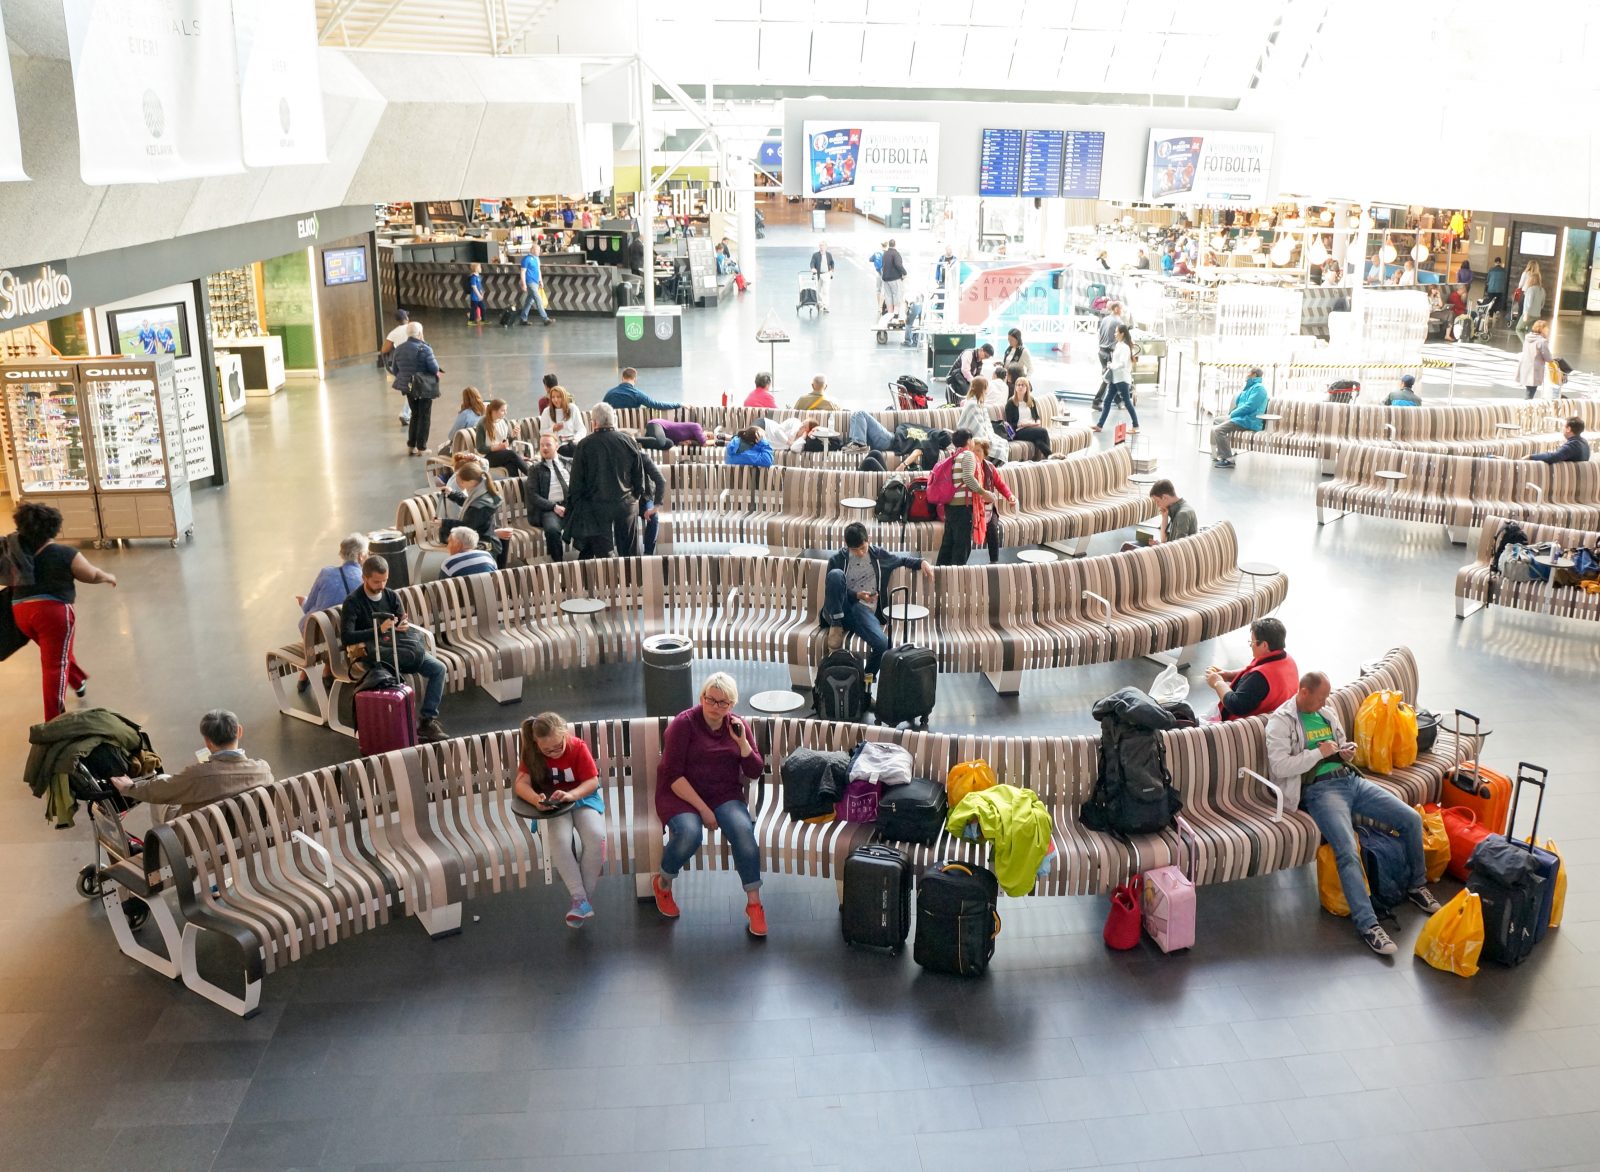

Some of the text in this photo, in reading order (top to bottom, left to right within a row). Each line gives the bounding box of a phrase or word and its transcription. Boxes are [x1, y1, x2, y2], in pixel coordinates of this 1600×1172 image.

[865, 144, 928, 164] FÓTBOLTA
[670, 189, 699, 216] THE
[297, 217, 315, 238] ELKO
[0, 264, 72, 319] Studio
[22, 370, 69, 378] OAKLEY
[102, 368, 148, 376] OAKLEY
